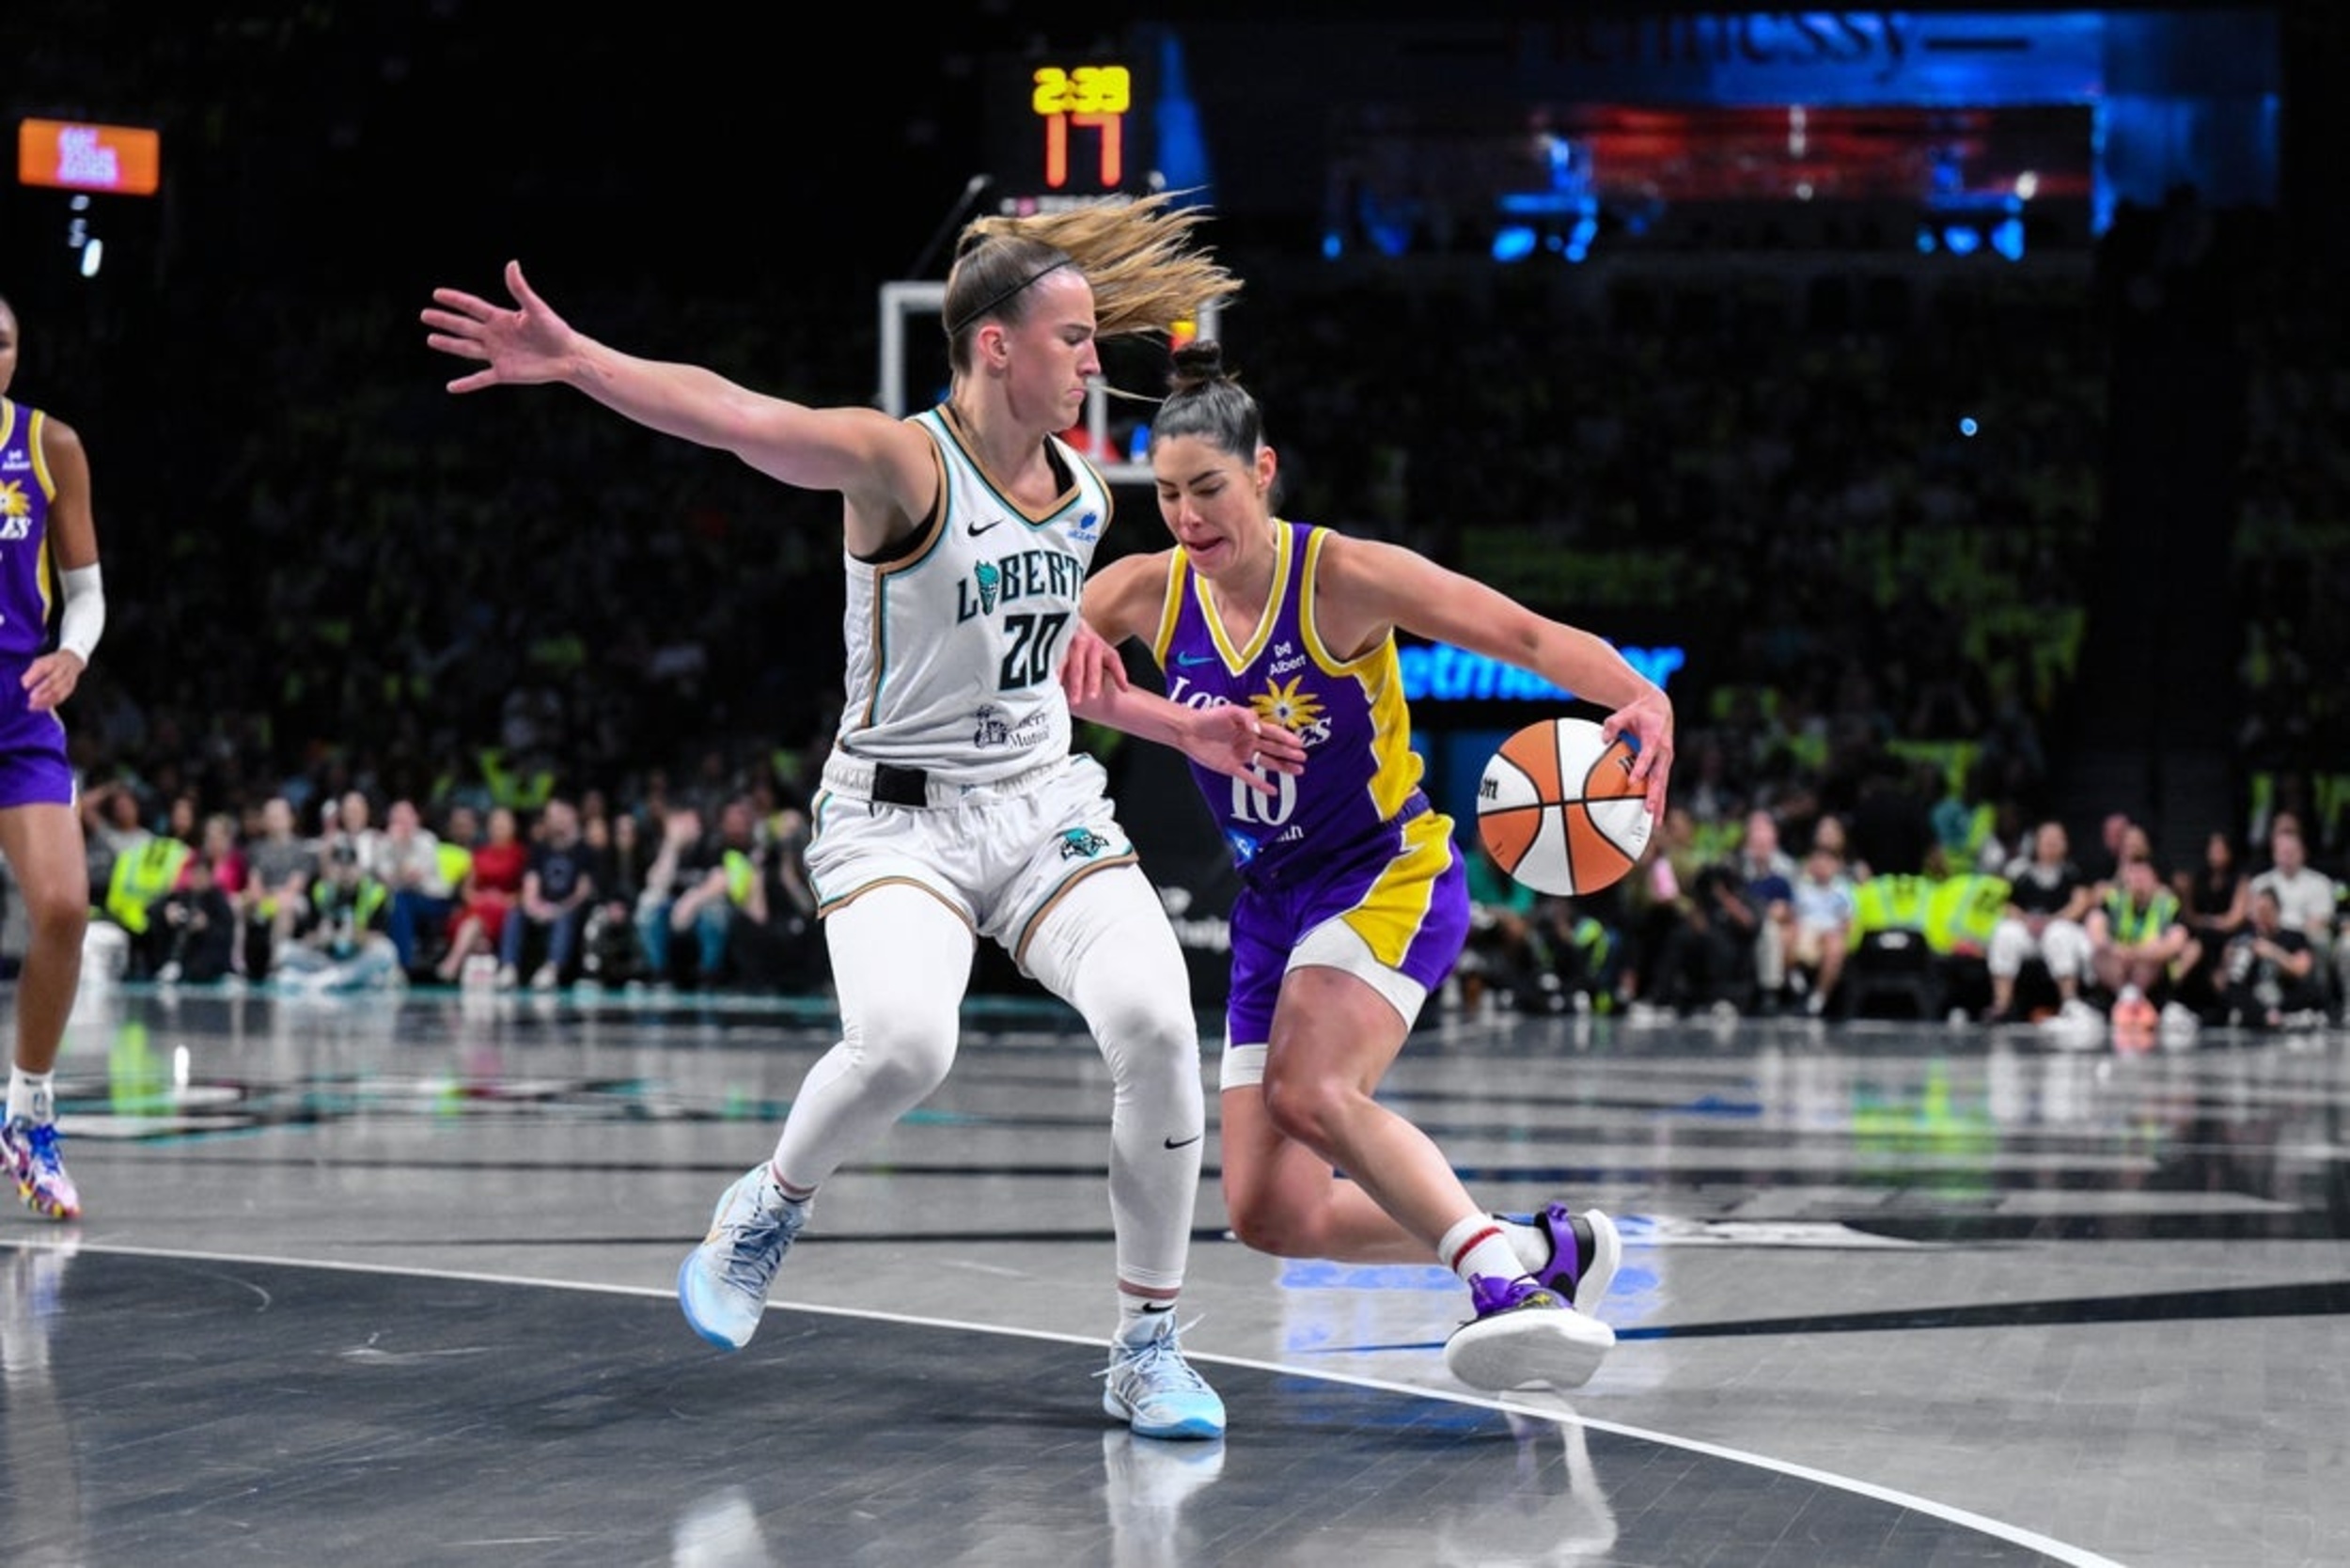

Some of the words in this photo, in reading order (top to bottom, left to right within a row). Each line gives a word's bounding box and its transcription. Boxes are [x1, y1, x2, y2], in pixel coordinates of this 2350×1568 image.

[1046, 112, 1121, 188] 17
[999, 613, 1070, 691] 20
[1269, 653, 1306, 676] Albert
[1230, 763, 1296, 825] 10
